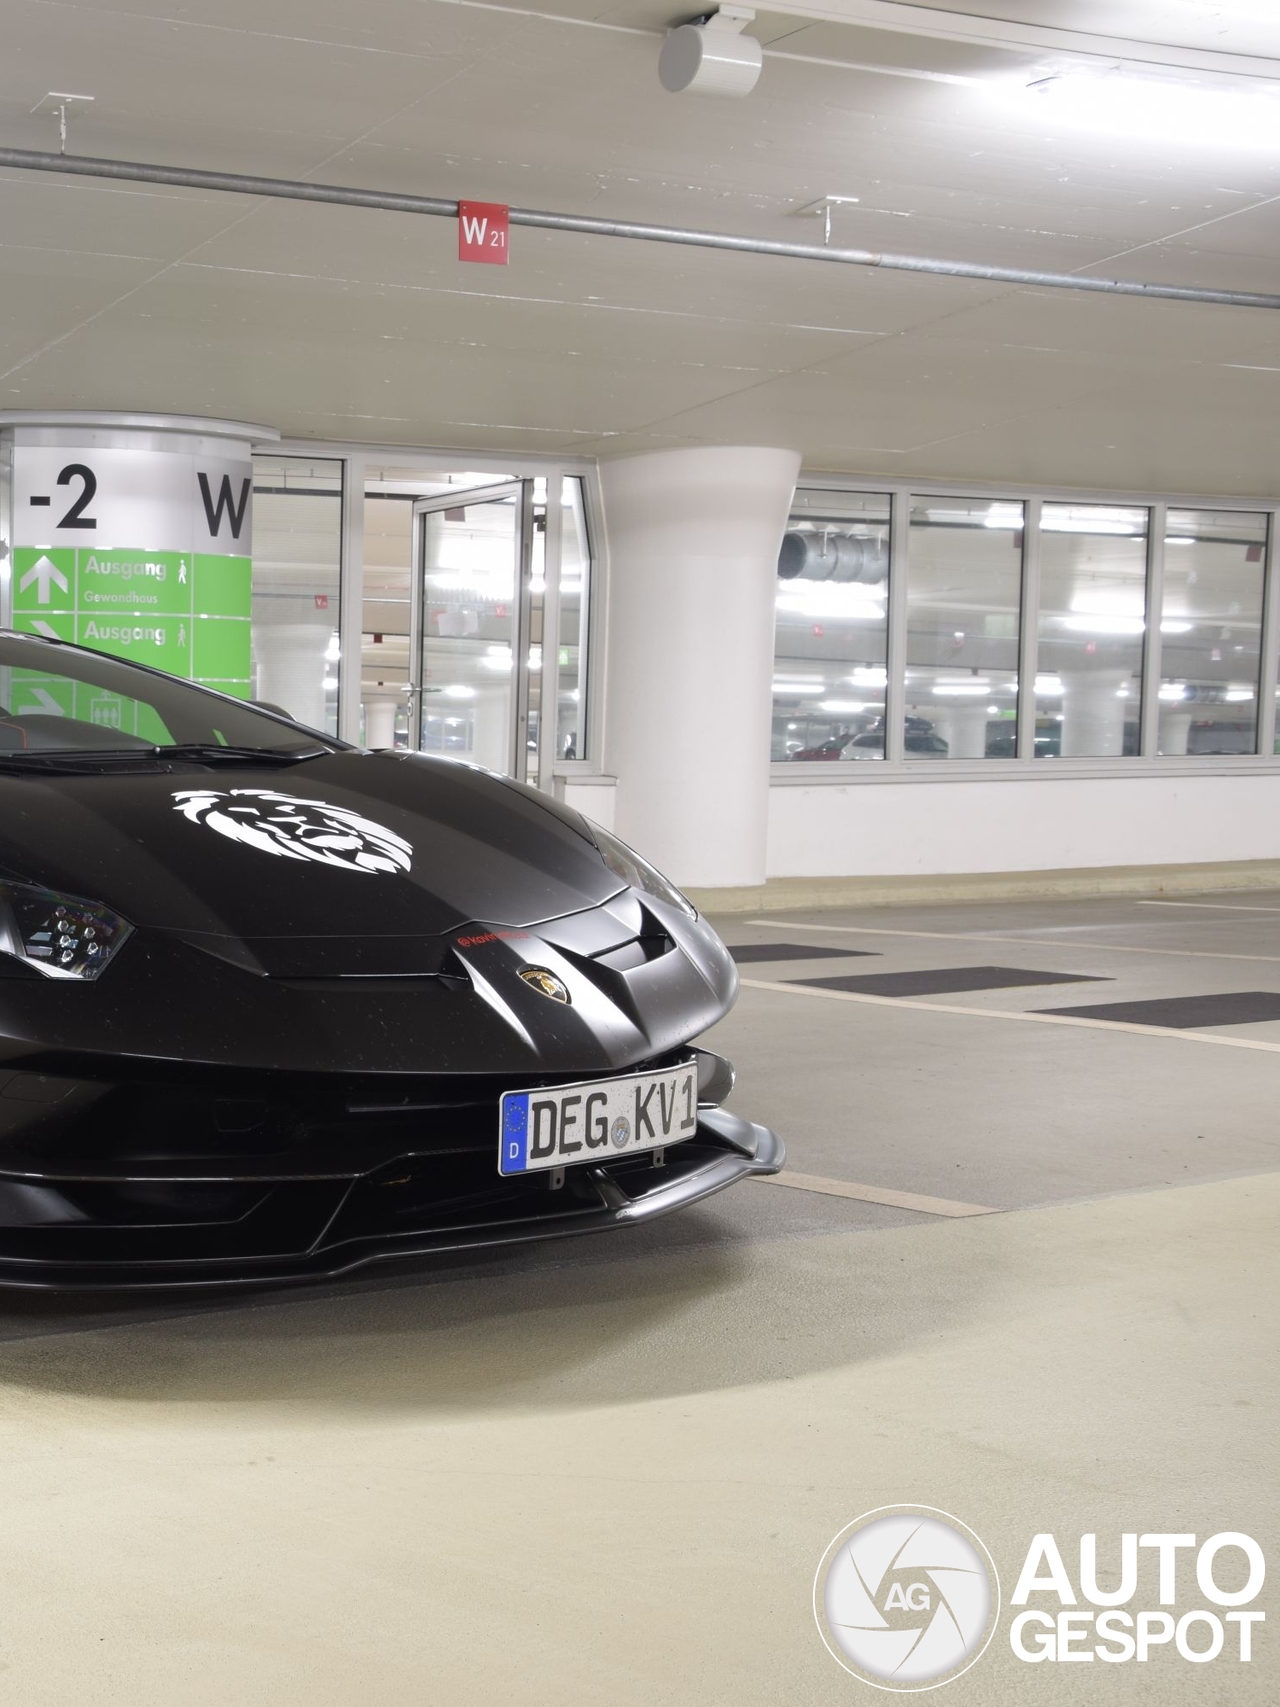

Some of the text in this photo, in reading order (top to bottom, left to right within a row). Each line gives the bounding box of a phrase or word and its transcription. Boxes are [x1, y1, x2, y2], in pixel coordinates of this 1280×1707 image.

[462, 215, 505, 248] W 21
[30, 463, 97, 529] -2
[197, 472, 252, 539] W
[84, 555, 167, 581] Ausgang
[83, 590, 158, 604] Gewandhaus
[83, 620, 166, 646] Ausgang
[530, 1092, 609, 1160] DEG
[509, 1142, 519, 1159] D
